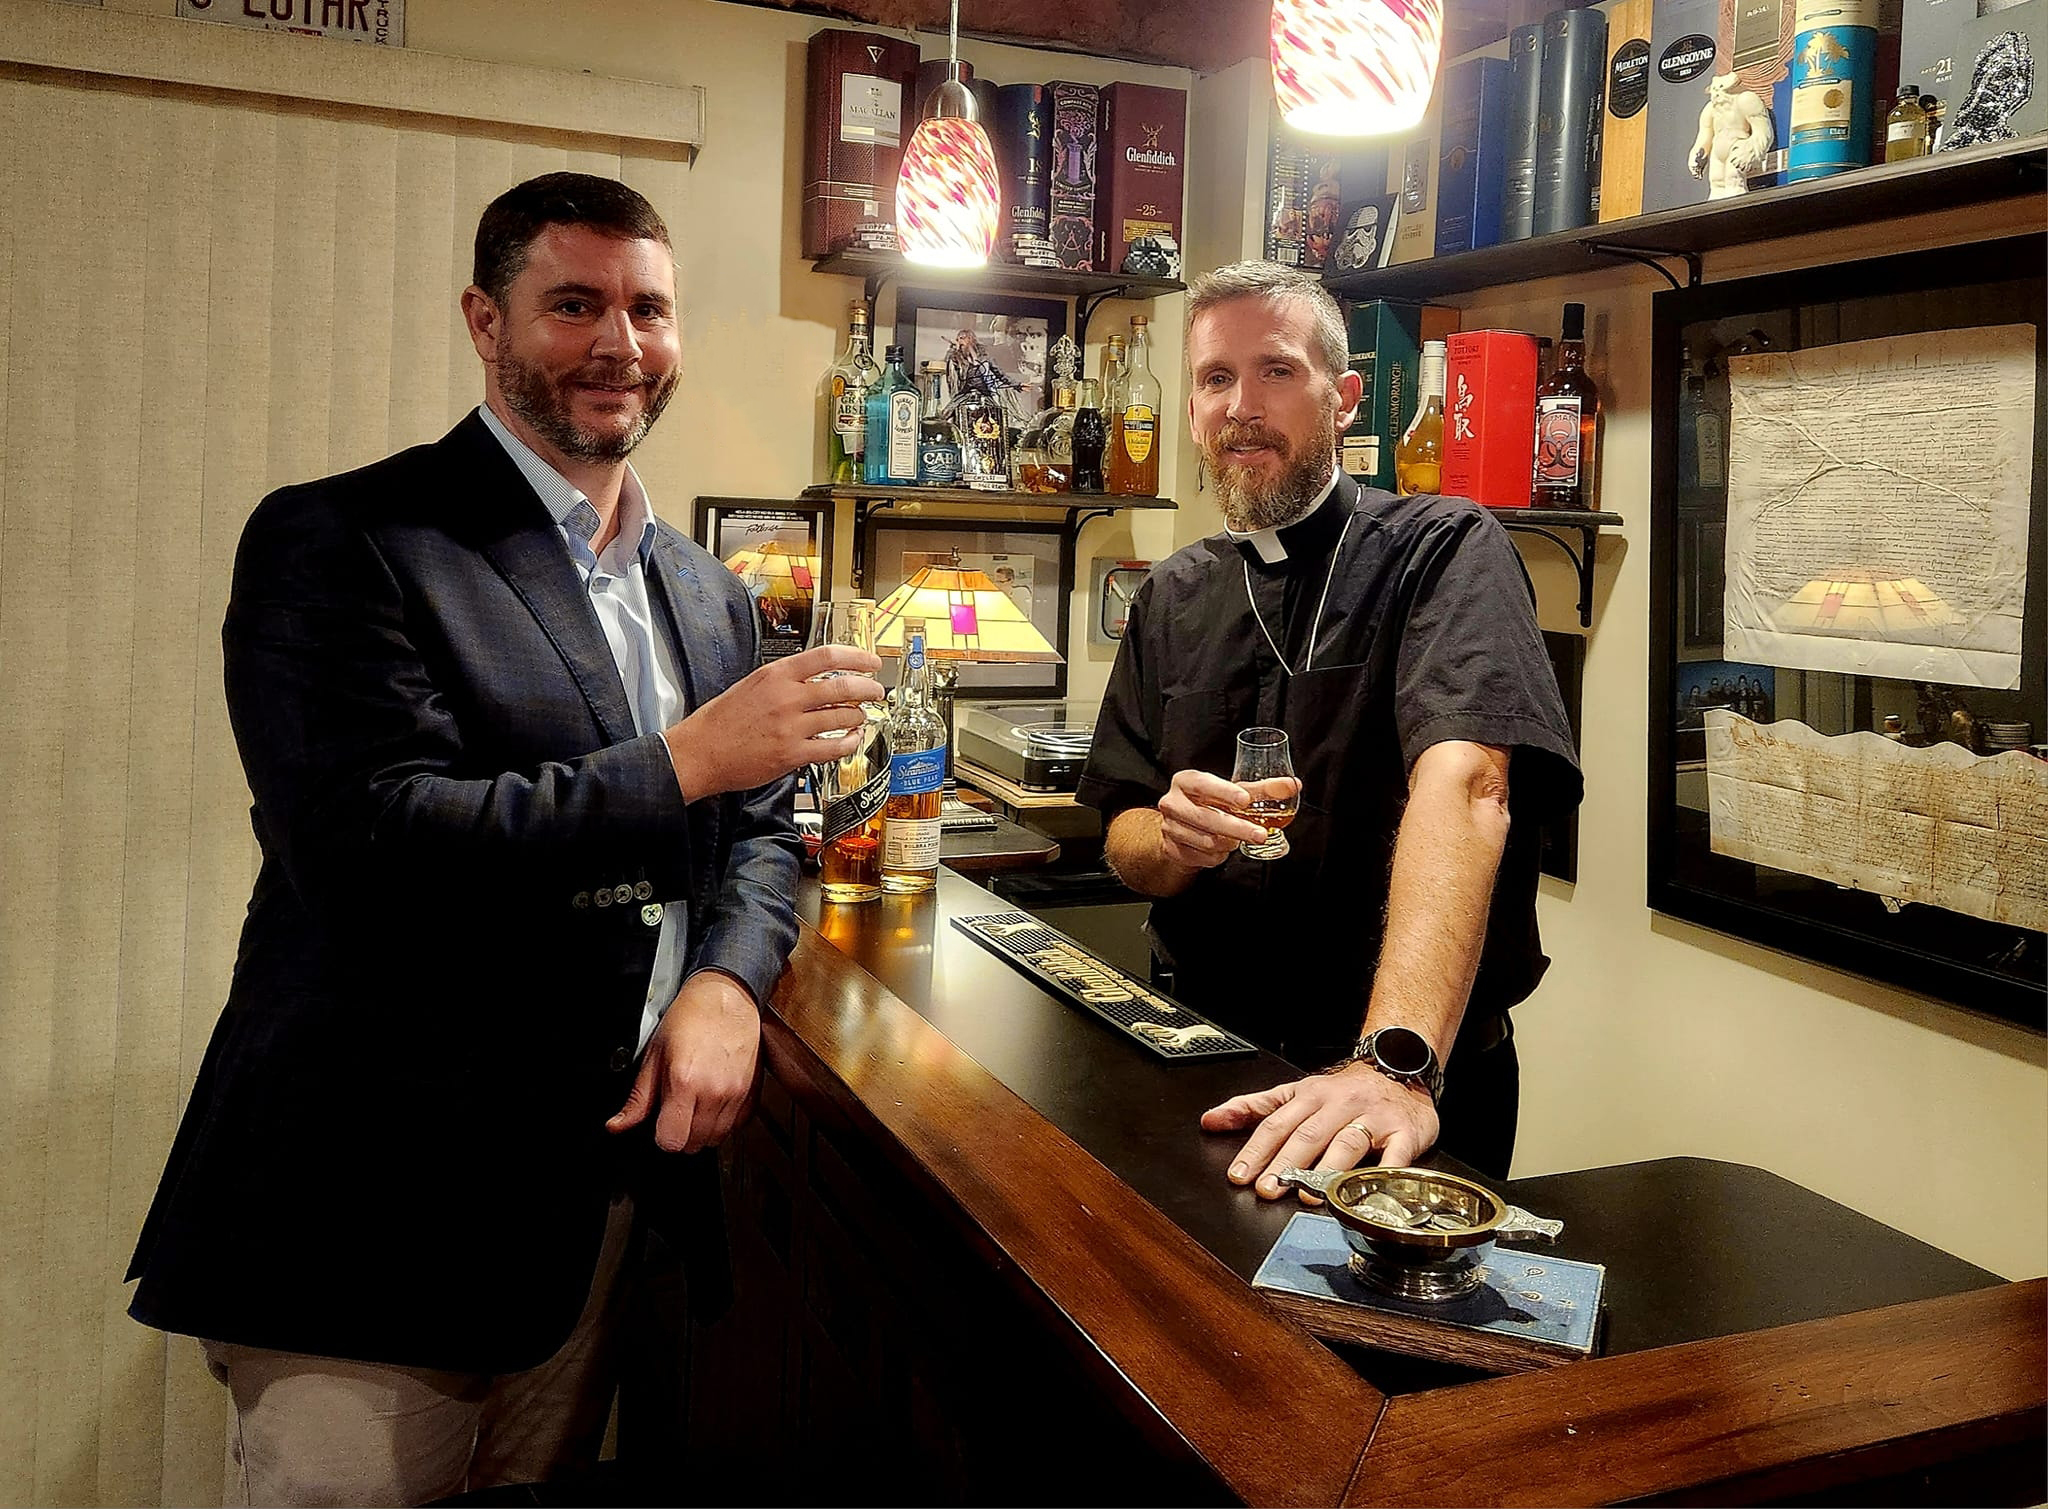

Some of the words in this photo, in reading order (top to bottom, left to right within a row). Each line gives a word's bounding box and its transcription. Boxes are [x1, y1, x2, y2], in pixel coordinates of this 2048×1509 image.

[1614, 54, 1649, 74] MIDLETON
[1661, 47, 1714, 70] GLENGOYNE
[1936, 57, 1953, 76] 21
[849, 104, 897, 120] MACALLAN
[1125, 146, 1177, 167] Glenfiddich
[1389, 360, 1403, 438] GLENMORANGIE
